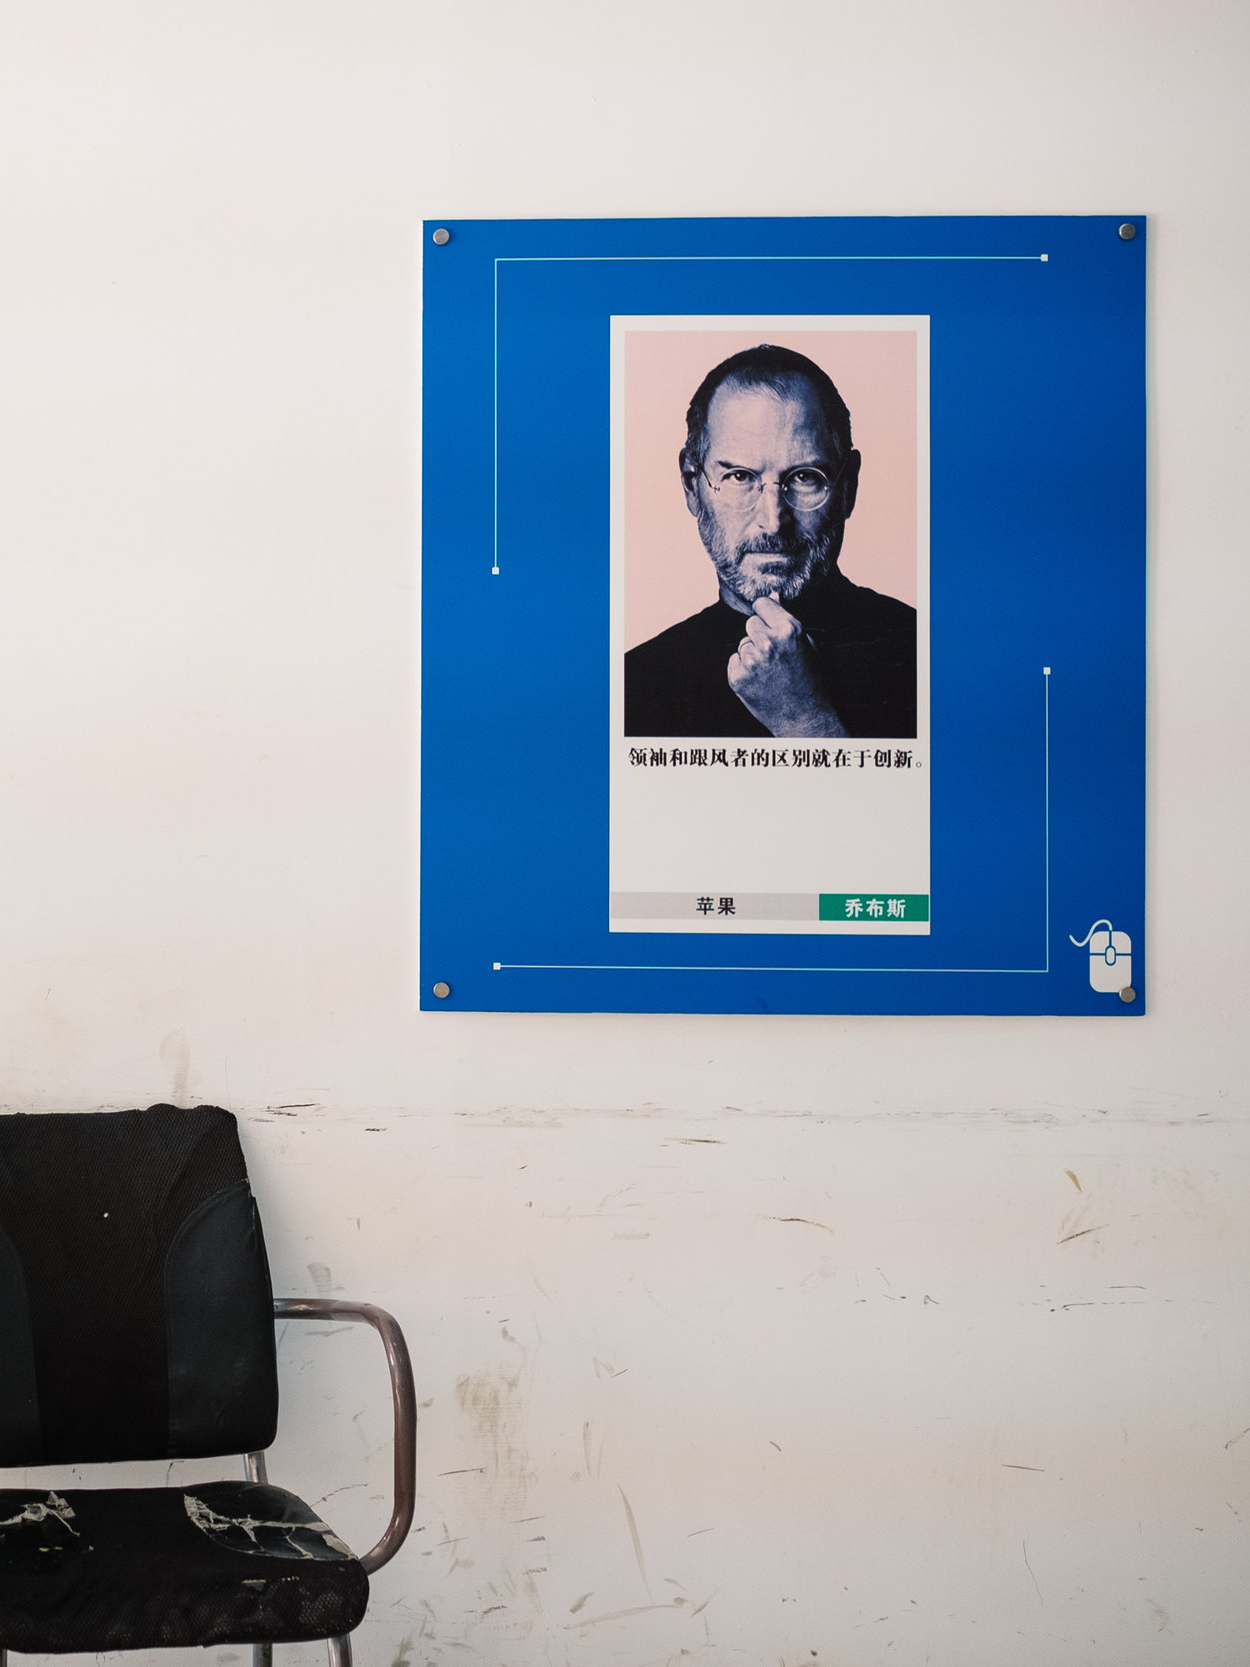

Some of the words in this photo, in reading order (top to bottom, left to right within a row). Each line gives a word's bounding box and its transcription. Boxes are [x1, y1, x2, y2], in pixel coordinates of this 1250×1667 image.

[628, 748, 923, 768] 领袖和跟风者的区别就在于创新。
[696, 896, 737, 916] 苹果
[844, 898, 907, 918] 乔布斯
